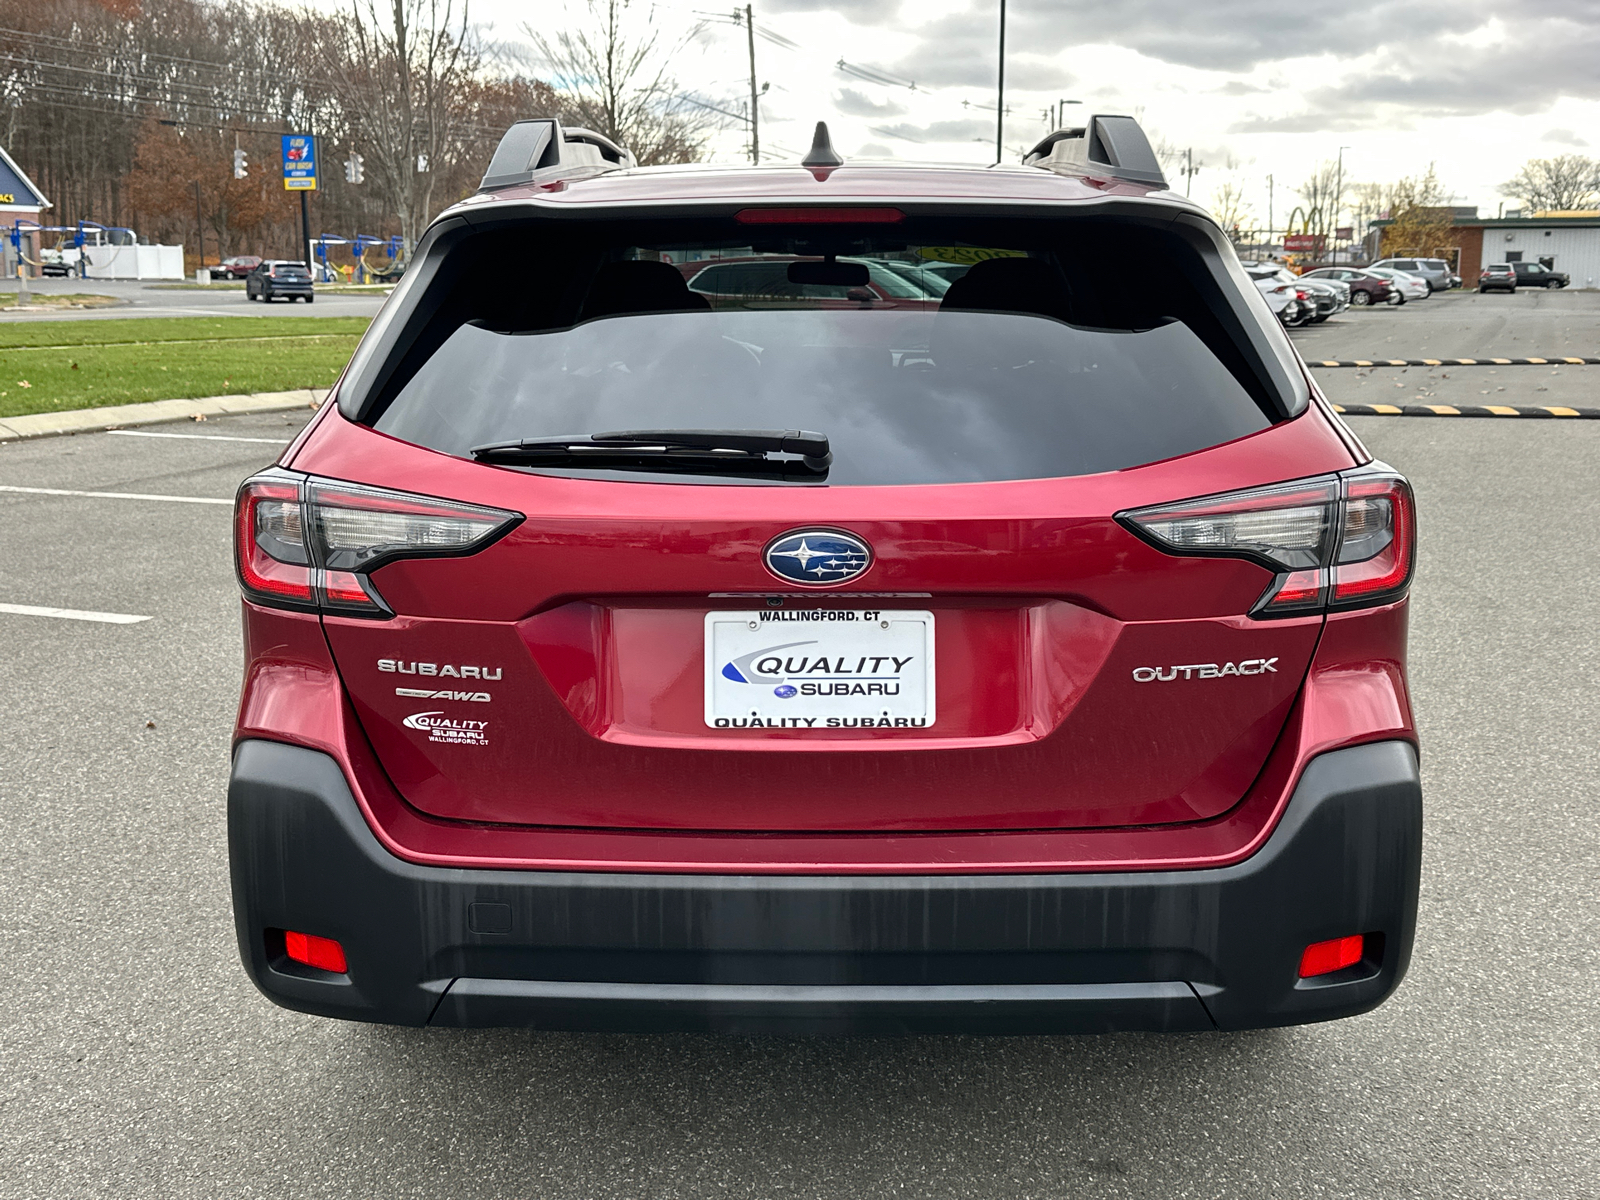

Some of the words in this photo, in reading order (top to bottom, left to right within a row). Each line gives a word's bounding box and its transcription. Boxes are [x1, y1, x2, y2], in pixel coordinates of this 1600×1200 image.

[759, 611, 859, 622] WALLINGFORD,
[863, 611, 880, 621] CT
[377, 659, 502, 680] SUBARU
[756, 656, 914, 675] QUALITY
[1132, 657, 1279, 682] OUTBACK
[431, 690, 491, 702] AWD
[800, 683, 900, 696] SUBARU
[417, 717, 489, 730] QUALITY
[714, 717, 817, 728] QUALITY
[826, 717, 926, 728] SUBARU
[432, 729, 484, 739] SUBARU
